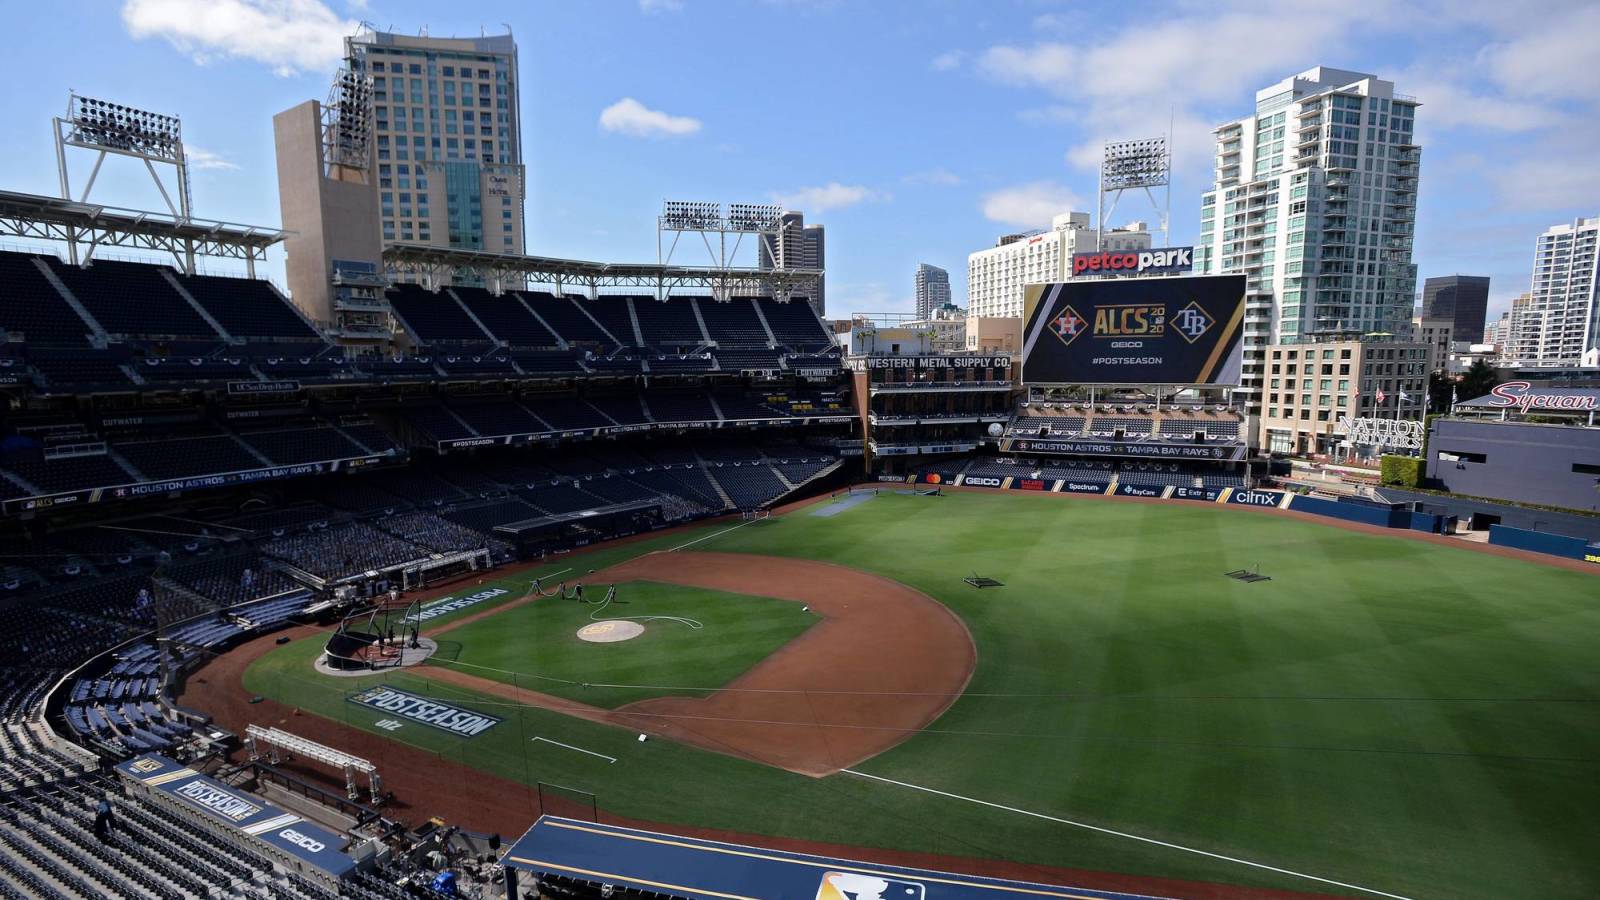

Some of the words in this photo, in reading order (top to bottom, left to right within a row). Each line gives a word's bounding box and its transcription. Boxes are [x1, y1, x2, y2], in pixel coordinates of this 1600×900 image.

[1093, 308, 1148, 334] ALCS
[868, 358, 915, 368] WESTERN
[920, 358, 951, 368] METAL
[954, 358, 990, 368] SUPPLY
[994, 358, 1010, 368] CO.
[1092, 357, 1162, 365] #POSTSEASON
[1489, 381, 1599, 414] Sycuan
[1031, 443, 1074, 451] HOUSTON
[1075, 444, 1111, 452] ASTROS
[1126, 446, 1159, 454] TAMPA
[1161, 447, 1180, 455] BAY
[1182, 448, 1210, 456] RAYS
[131, 482, 184, 496] HOUSTON
[185, 476, 225, 492] ASTROS
[240, 470, 271, 481] TAMPA
[272, 468, 289, 477] BAY
[290, 465, 312, 475] RAYS
[965, 477, 1000, 486] GEICO
[1068, 483, 1097, 491] Spectrum
[1132, 488, 1155, 496] BayCare
[1236, 491, 1275, 505] citrix
[364, 691, 496, 736] POSTSEASON
[375, 719, 403, 731] utz
[177, 781, 253, 817] POSTSEASON
[279, 829, 325, 852] GEICO
